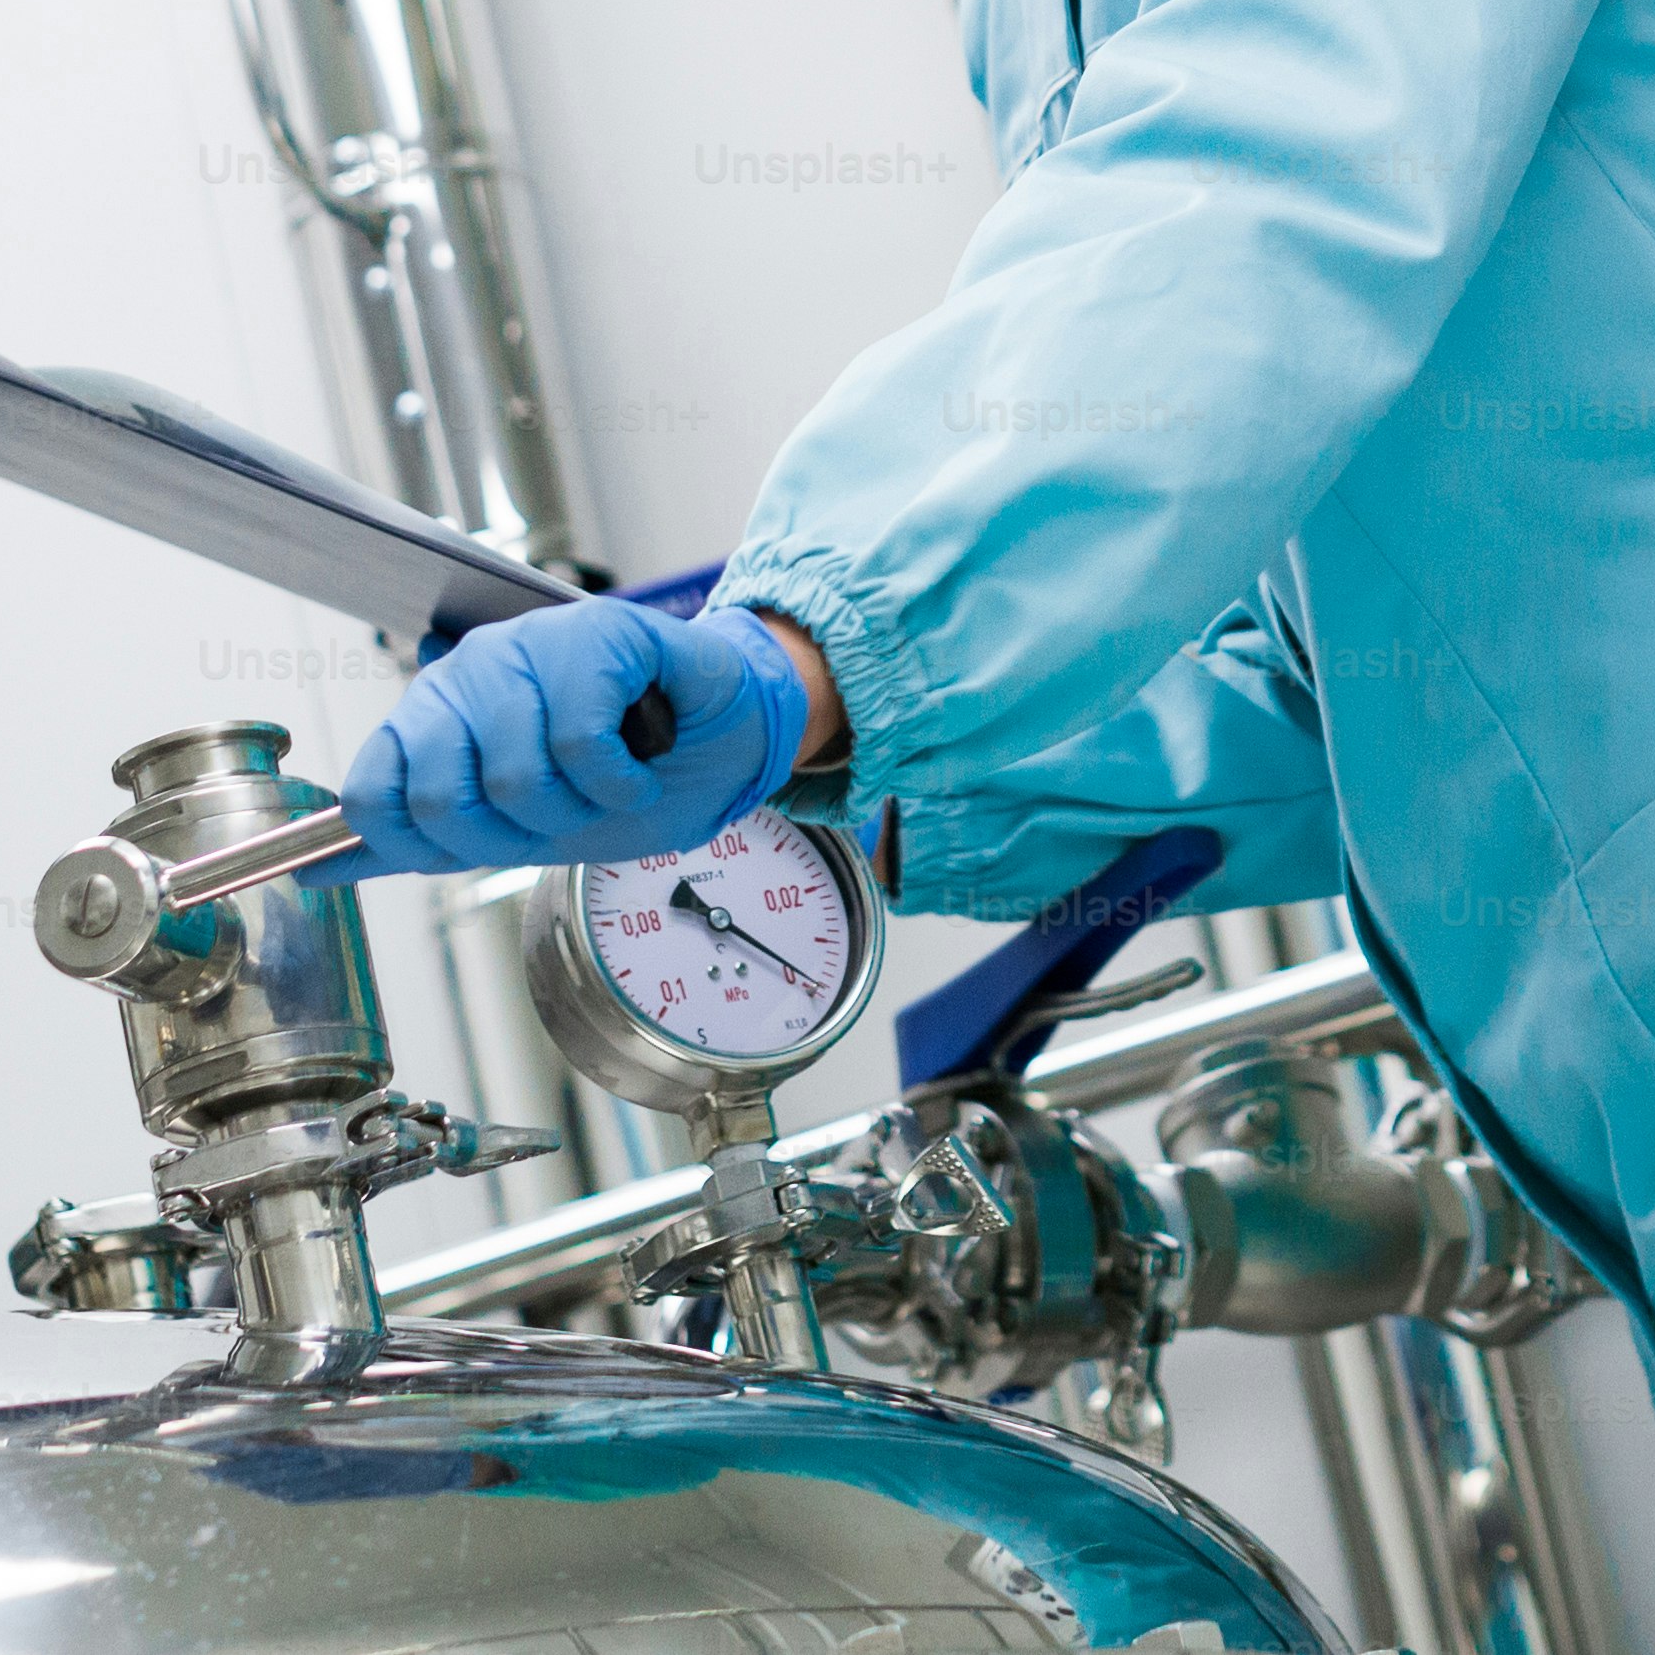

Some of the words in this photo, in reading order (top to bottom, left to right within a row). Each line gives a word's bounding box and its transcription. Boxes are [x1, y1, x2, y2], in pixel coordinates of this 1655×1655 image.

[710, 833, 749, 862] 0,04
[764, 885, 803, 916] 0,02
[621, 909, 661, 939] 0,08
[783, 966, 796, 986] 0
[660, 977, 687, 1007] 0,1
[697, 1028, 708, 1045] S
